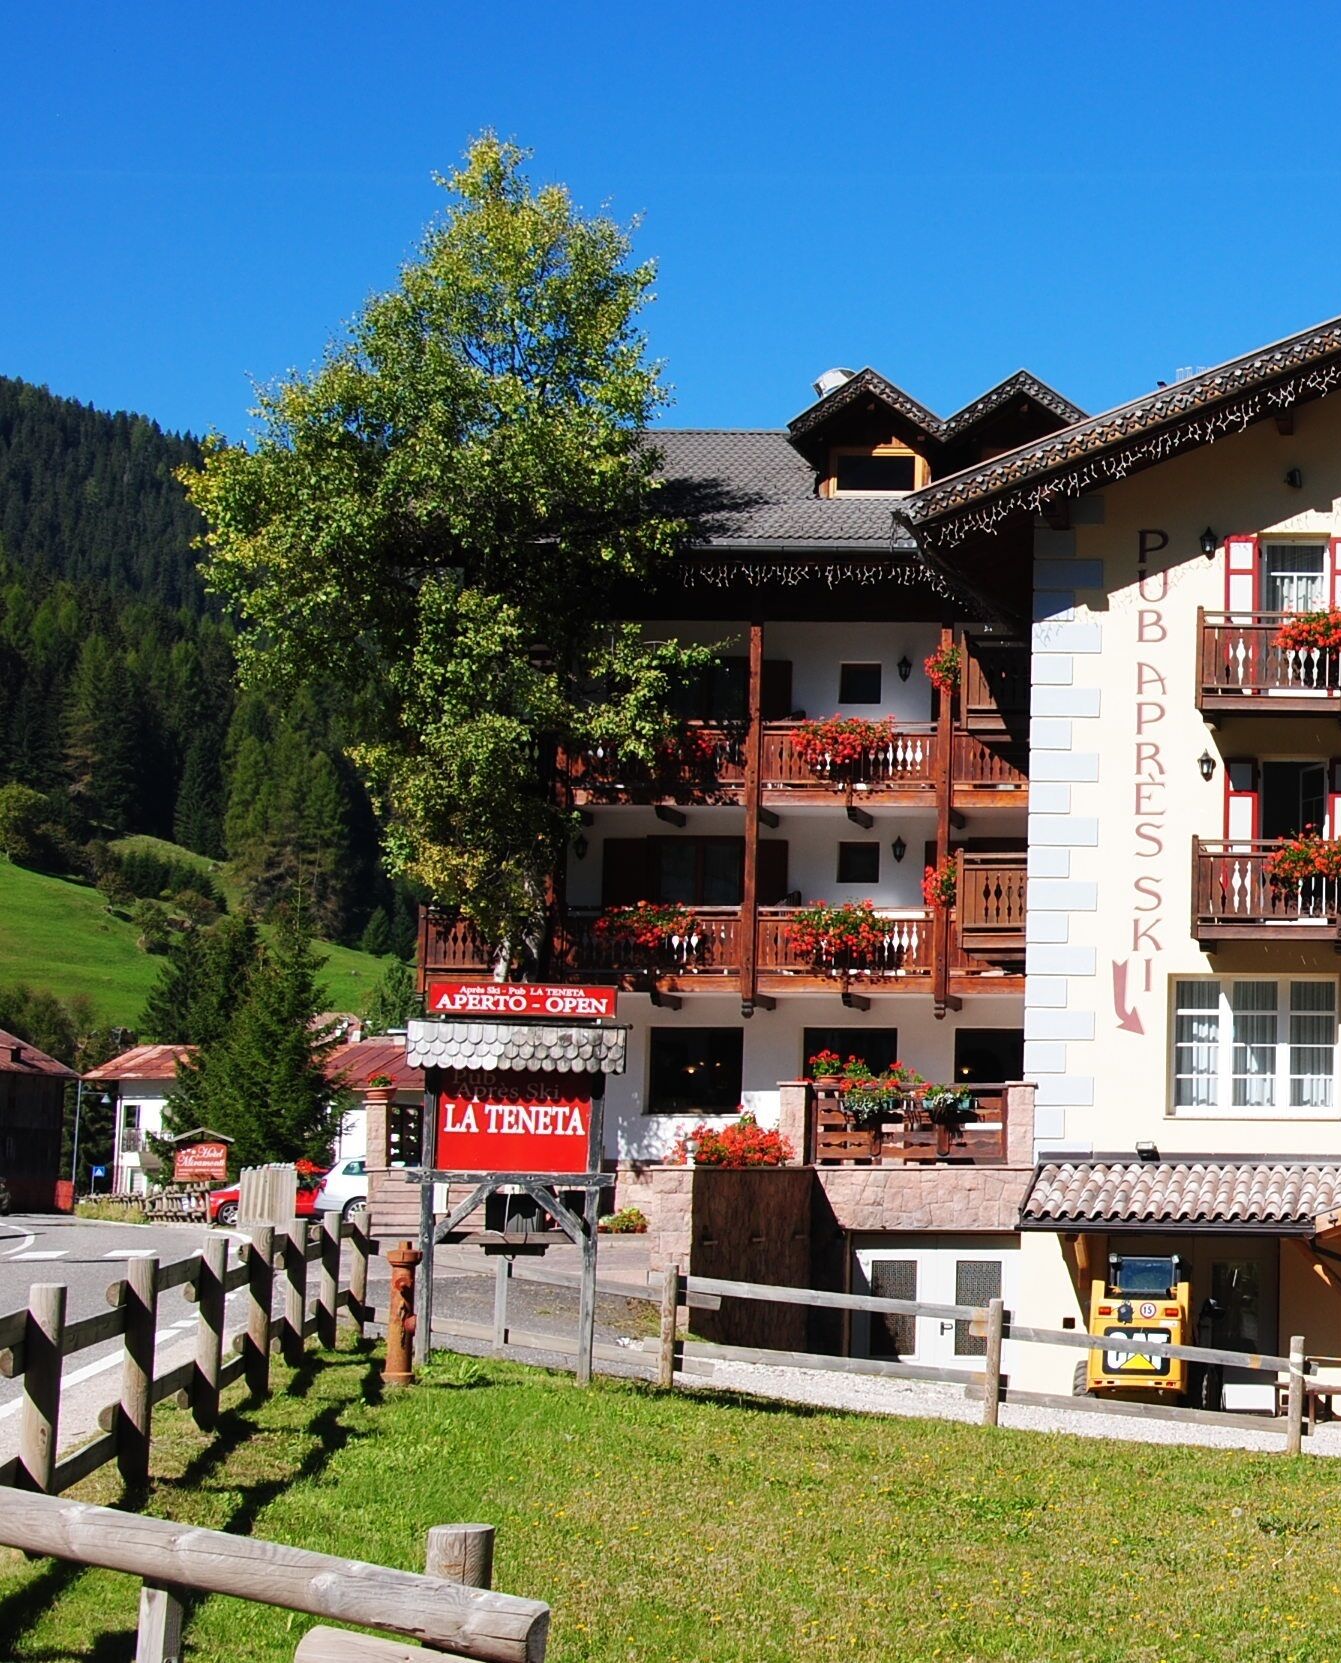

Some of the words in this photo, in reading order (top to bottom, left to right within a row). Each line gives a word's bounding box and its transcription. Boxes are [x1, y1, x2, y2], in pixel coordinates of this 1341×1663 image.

[1137, 529, 1169, 643] PUB
[1134, 662, 1167, 857] APRÈS
[1132, 876, 1163, 992] SKI
[487, 986, 501, 994] Ski
[508, 986, 526, 996] Pub
[530, 987, 544, 996] LA
[545, 988, 585, 997] TENETA
[436, 994, 527, 1011] APERTO
[545, 996, 608, 1014] OPEN
[453, 1071, 497, 1086] Pub
[456, 1082, 519, 1103] Après
[526, 1083, 560, 1099] Ski
[443, 1104, 479, 1133] LA
[484, 1105, 586, 1136] TENETA
[177, 1155, 226, 1167] Miramonti
[197, 1146, 224, 1158] Hotel
[1143, 1304, 1153, 1315] 15
